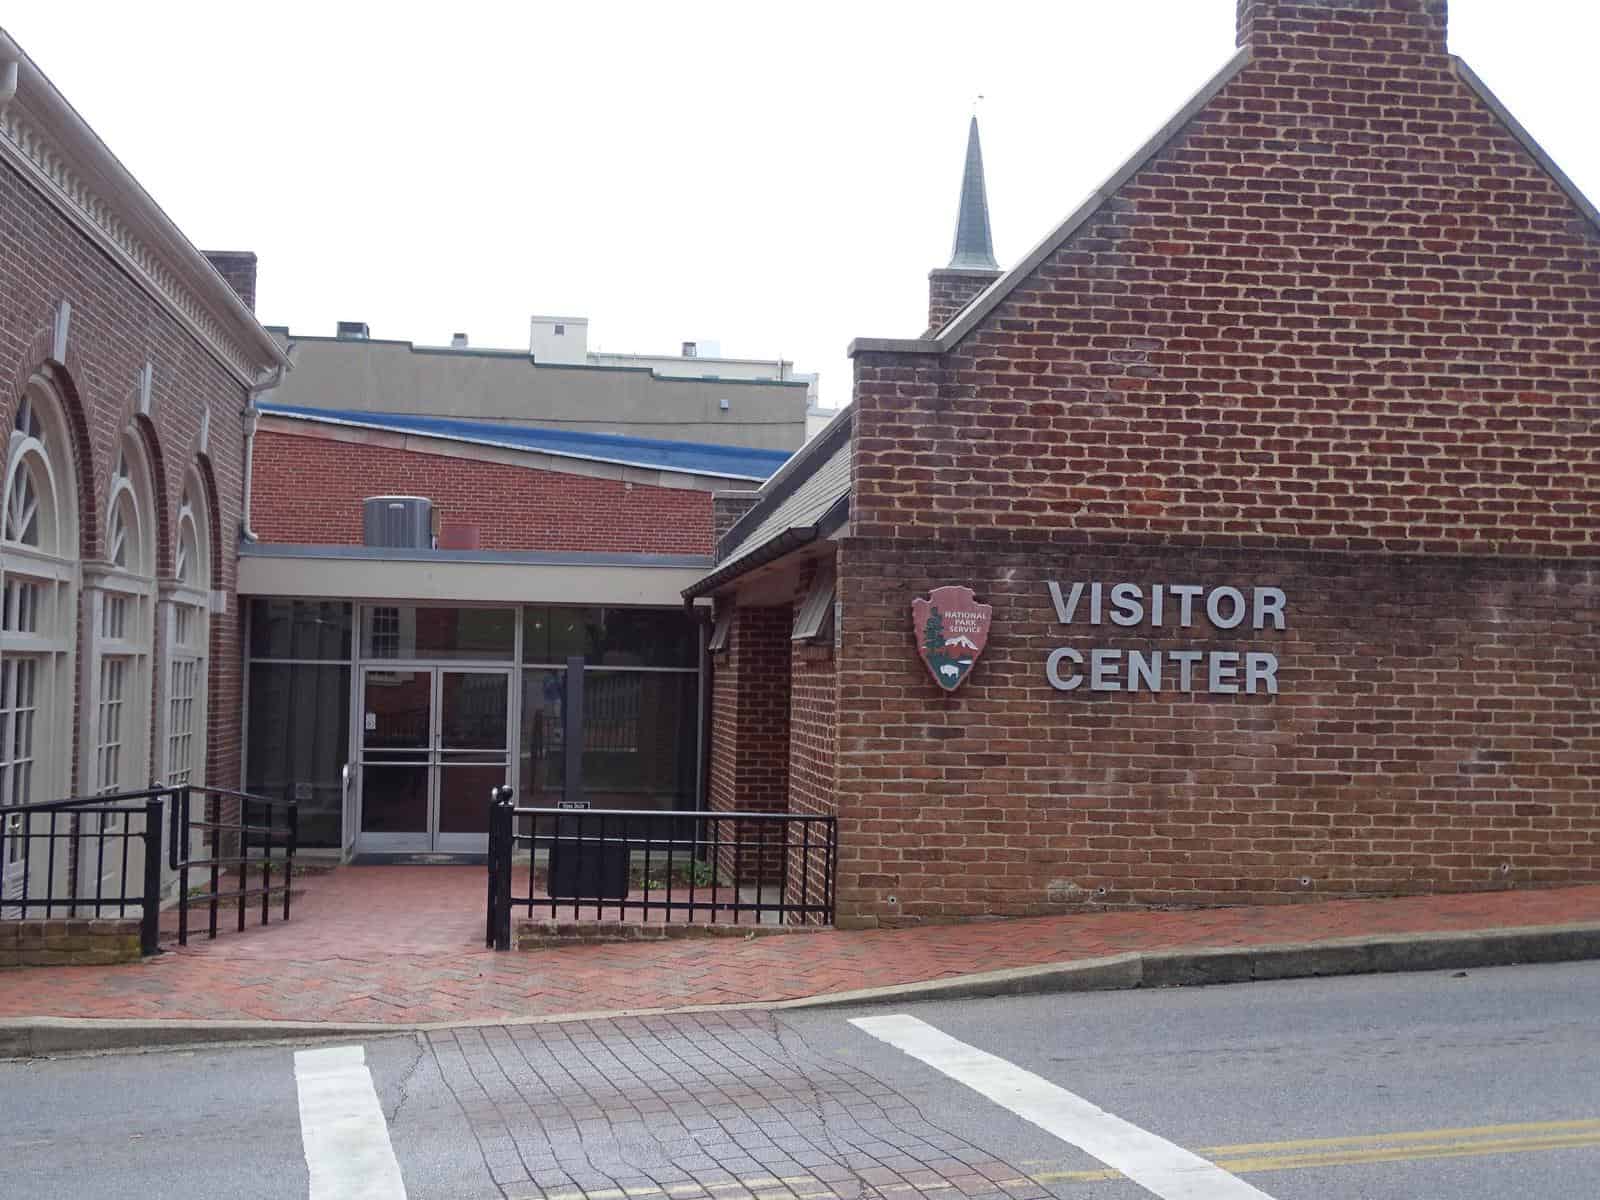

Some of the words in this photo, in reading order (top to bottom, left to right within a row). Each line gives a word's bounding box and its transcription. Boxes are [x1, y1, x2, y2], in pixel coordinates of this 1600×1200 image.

[944, 611, 985, 619] NATIONAL
[1048, 582, 1287, 630] VISITOR
[950, 625, 980, 633] SERVICE
[1046, 647, 1279, 695] CENTER
